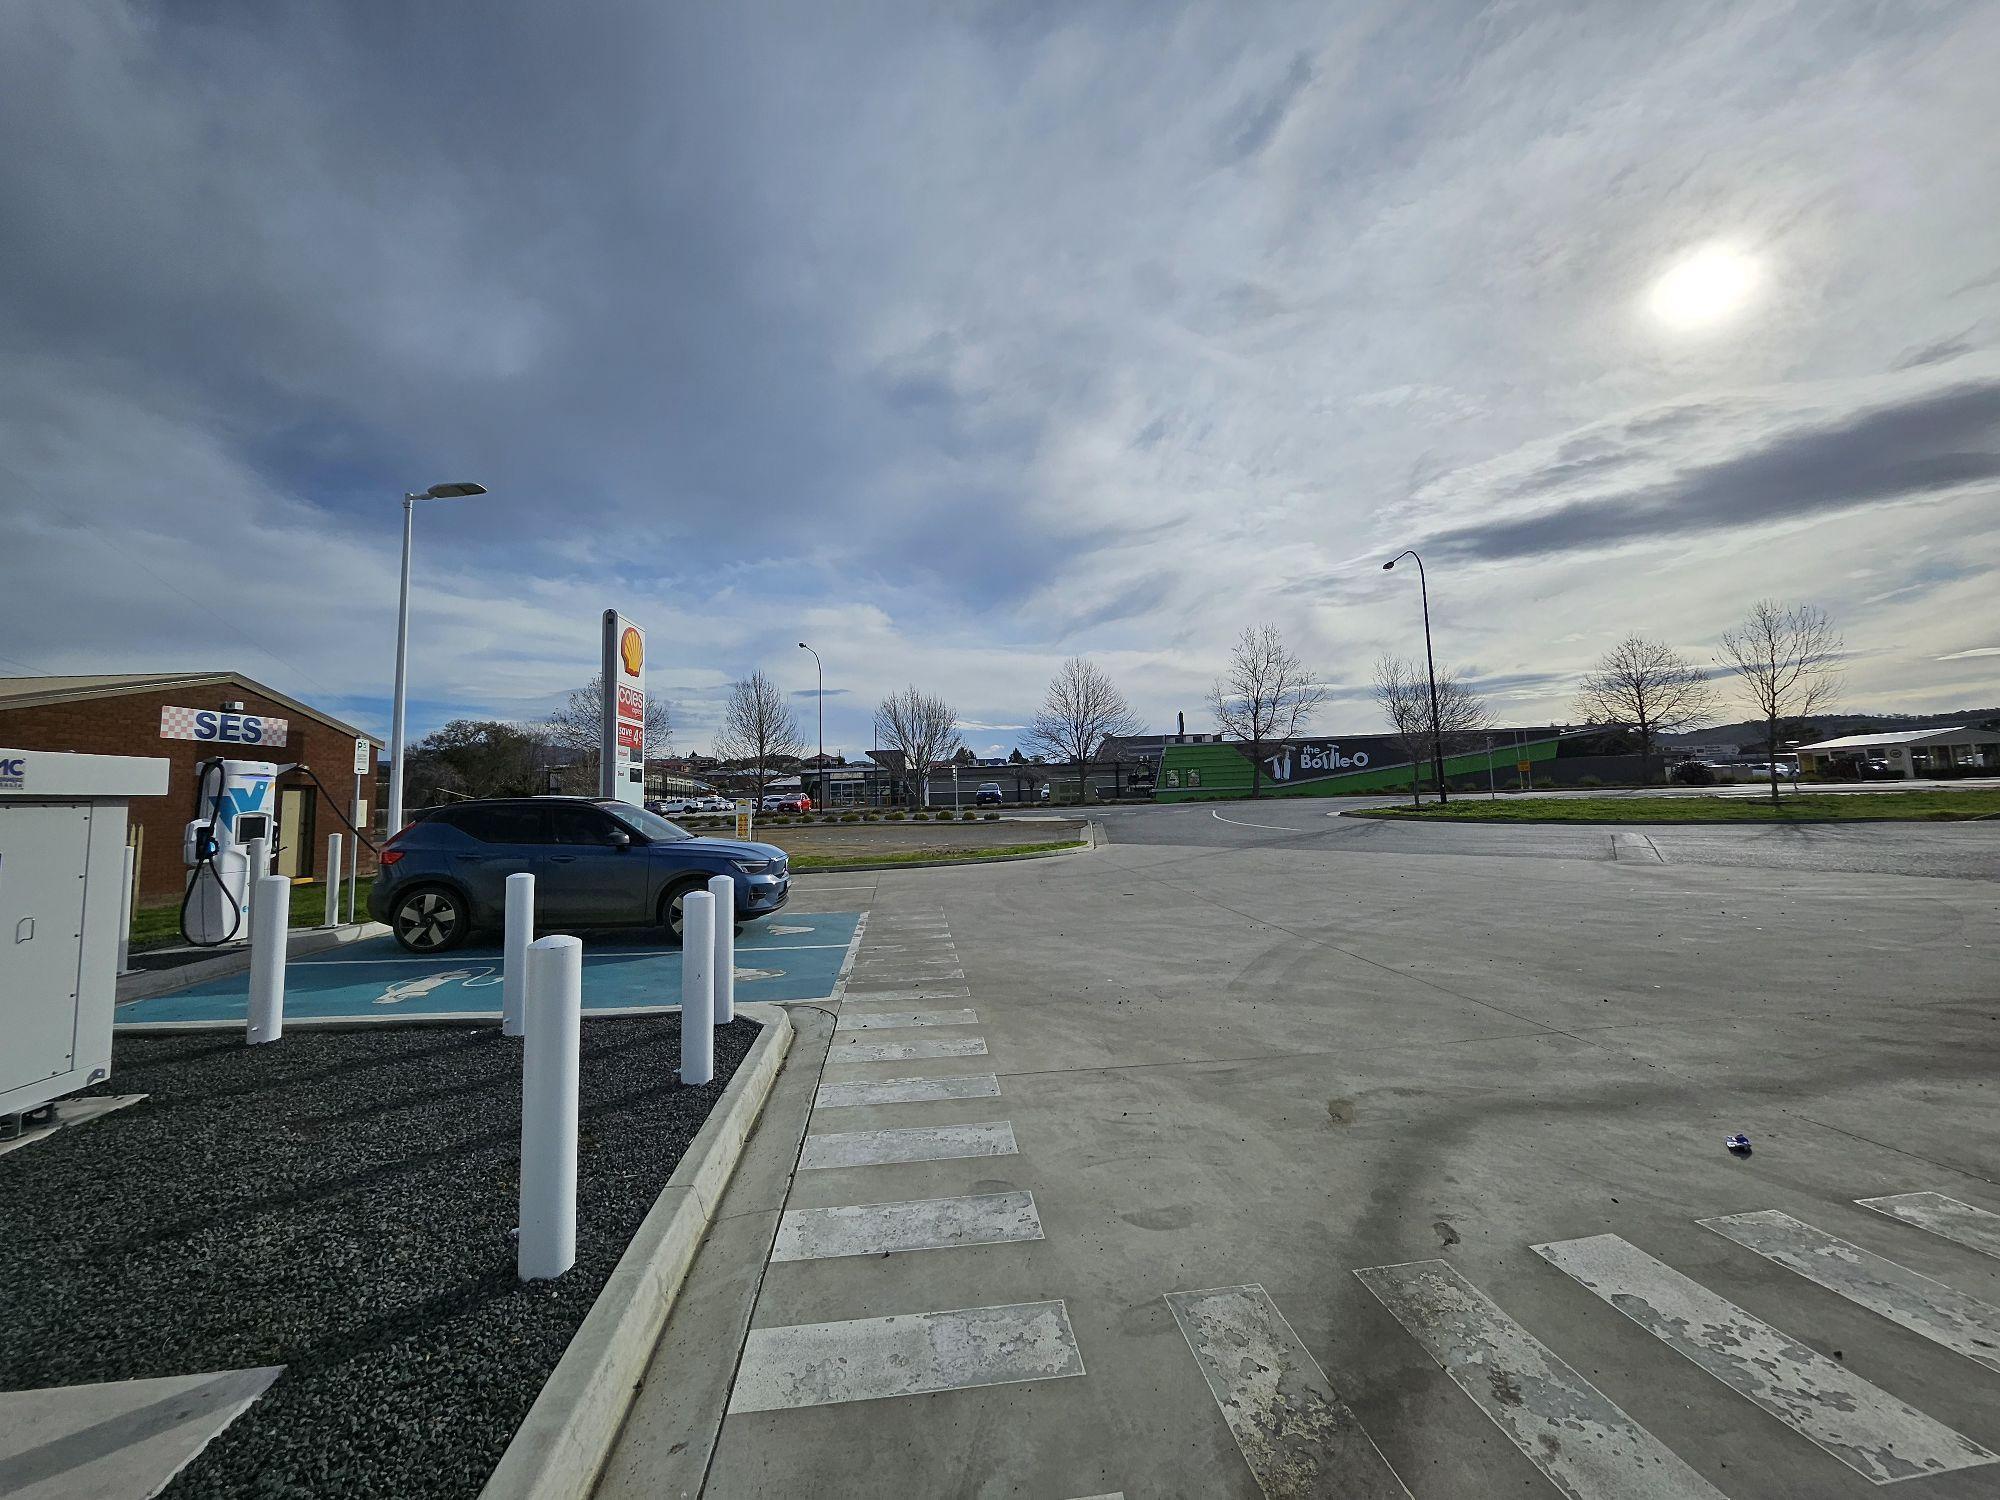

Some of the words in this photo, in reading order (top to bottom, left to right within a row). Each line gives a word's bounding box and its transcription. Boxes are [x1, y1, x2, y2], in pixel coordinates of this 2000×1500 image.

[619, 687, 643, 709] coles
[194, 711, 262, 744] SES
[618, 726, 633, 737] save
[1303, 744, 1321, 755] the
